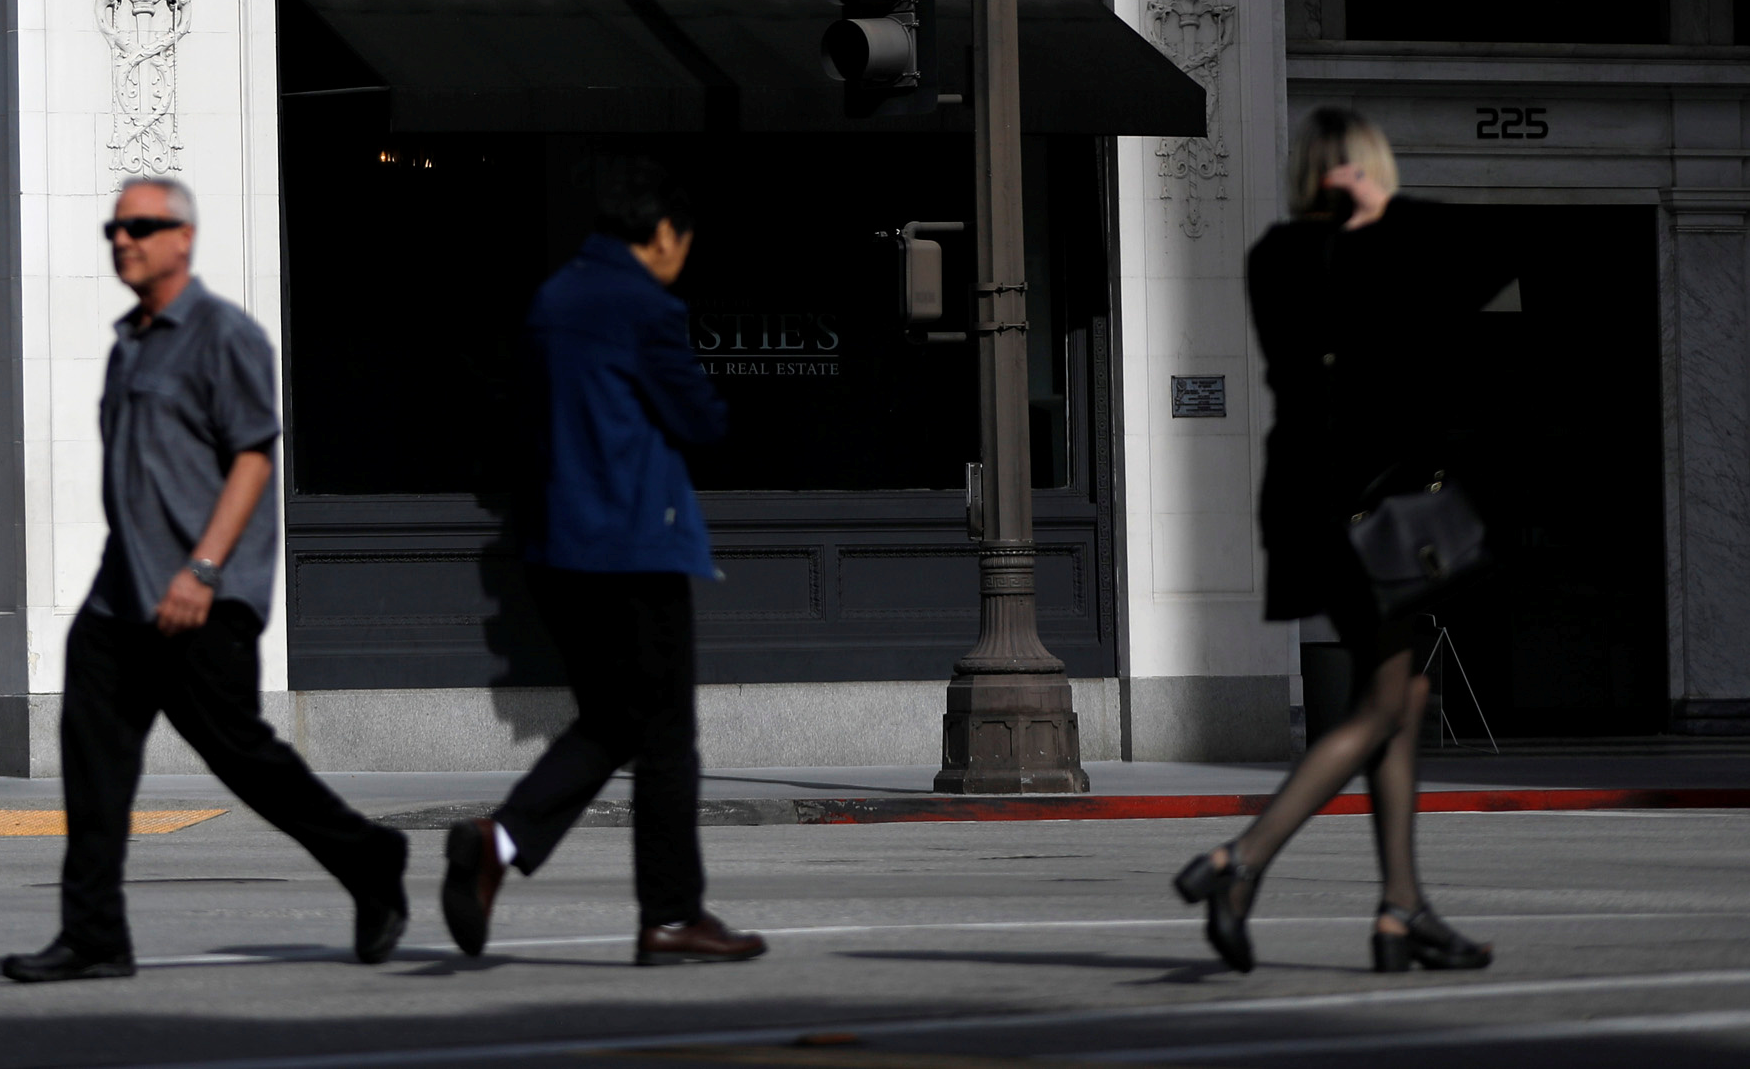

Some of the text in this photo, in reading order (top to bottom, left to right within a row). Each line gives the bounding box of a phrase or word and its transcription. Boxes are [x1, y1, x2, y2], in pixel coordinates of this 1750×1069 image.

[1476, 108, 1549, 139] 225
[726, 362, 770, 375] REAL
[776, 362, 840, 376] ESTATE
